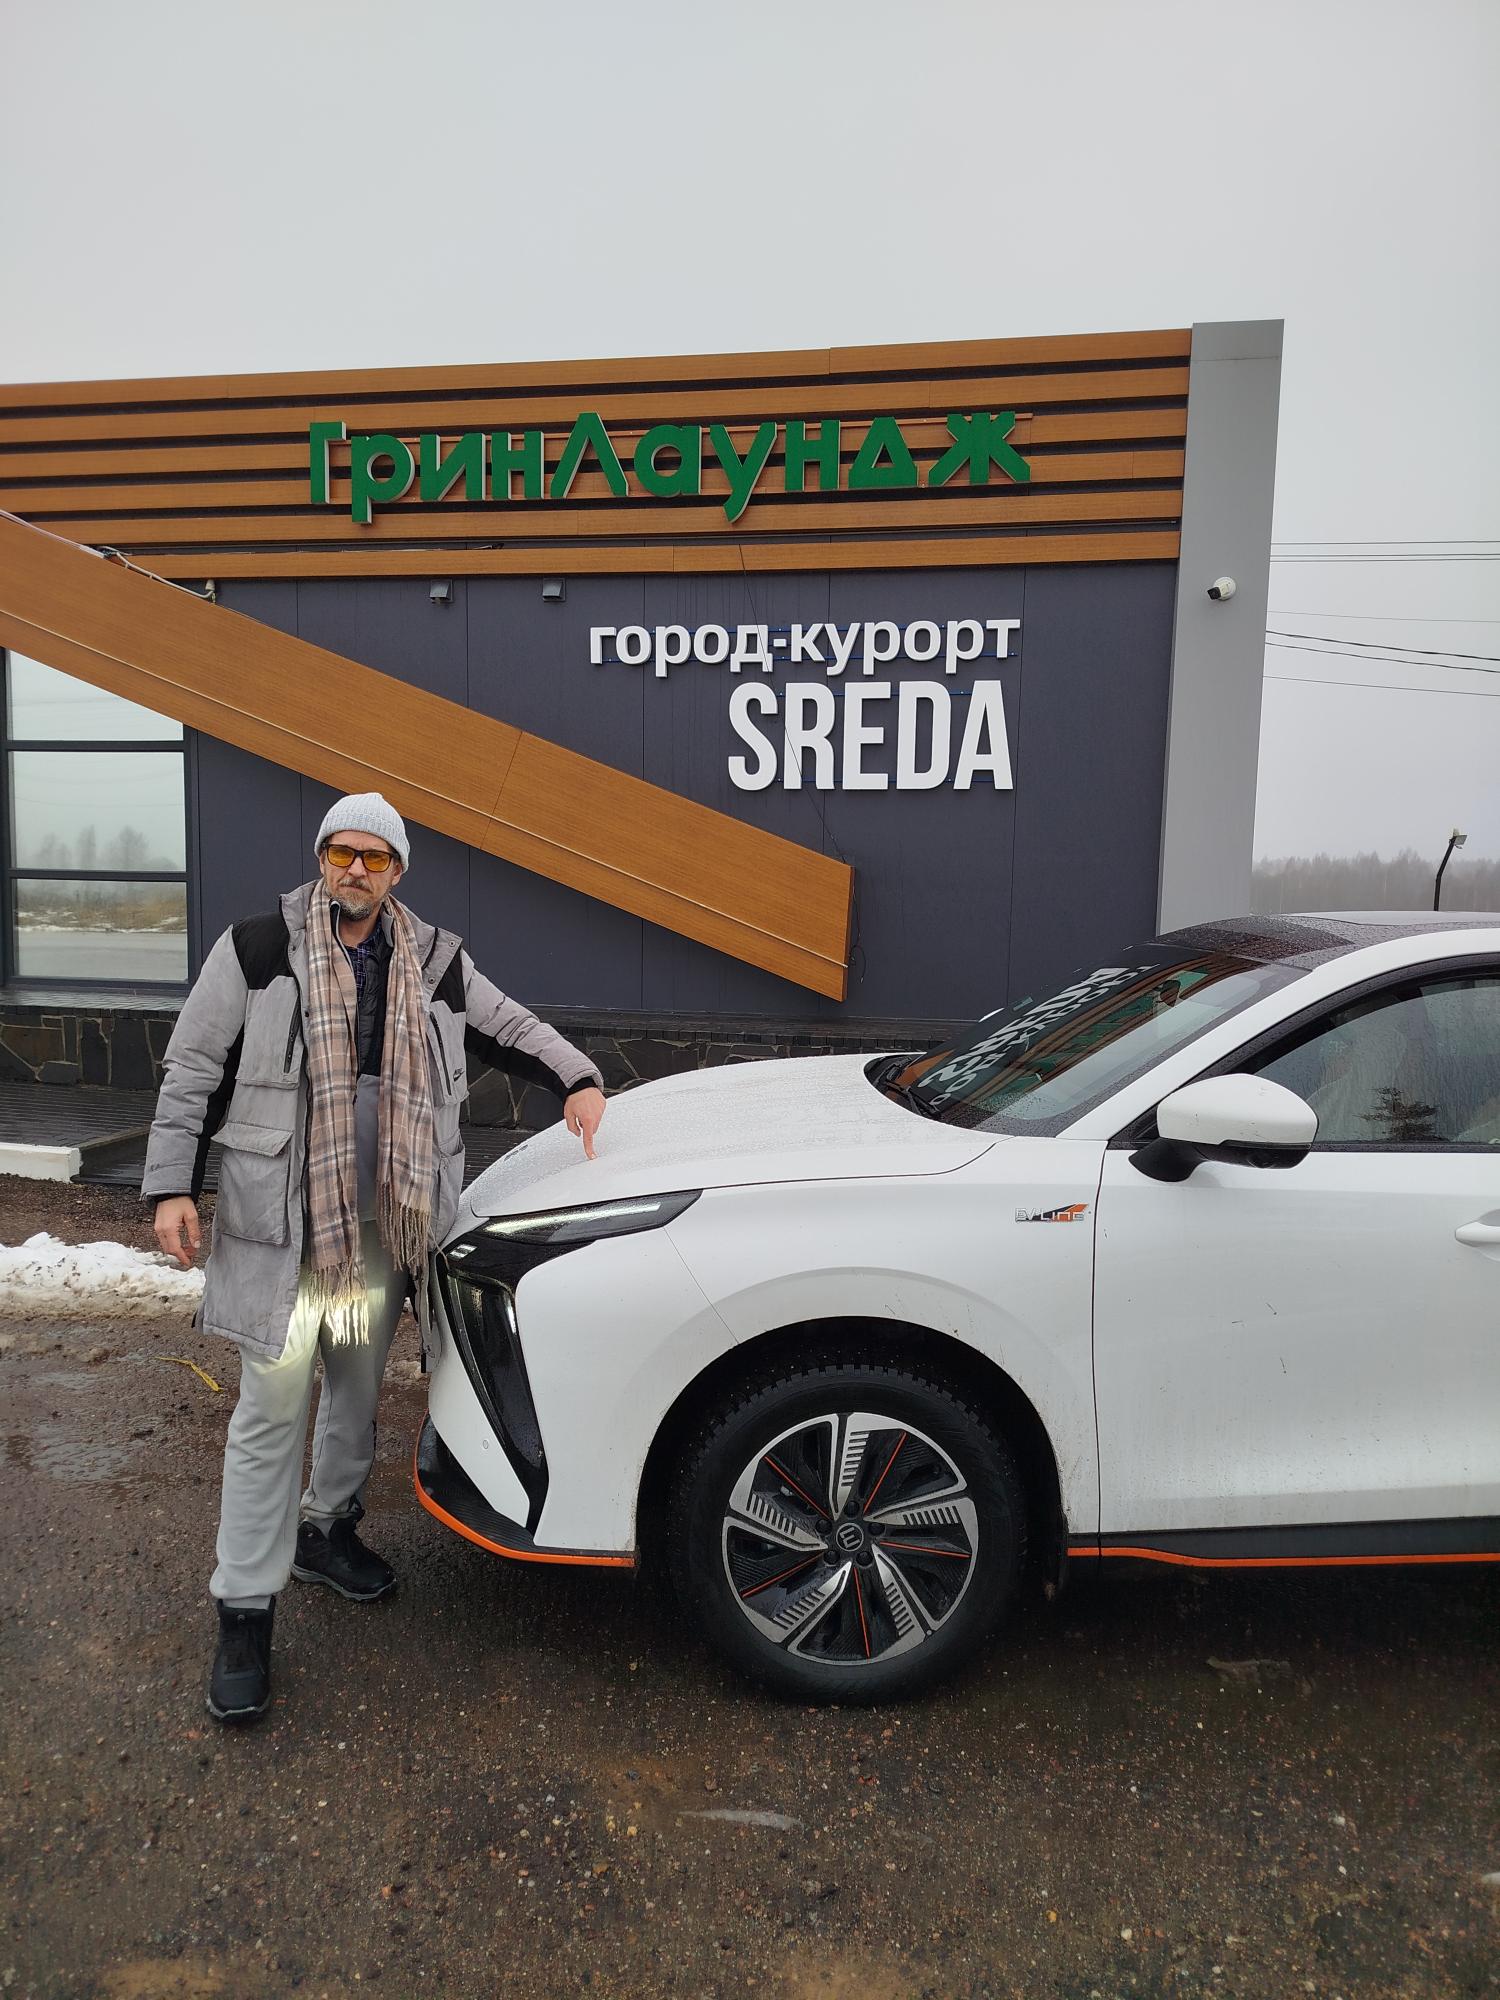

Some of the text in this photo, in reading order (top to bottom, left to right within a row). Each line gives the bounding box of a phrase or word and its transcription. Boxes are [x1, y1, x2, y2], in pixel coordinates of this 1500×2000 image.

[309, 412, 1031, 523] ГринЛаундж
[589, 618, 1020, 677] город-курорт
[729, 680, 1013, 790] SREDA
